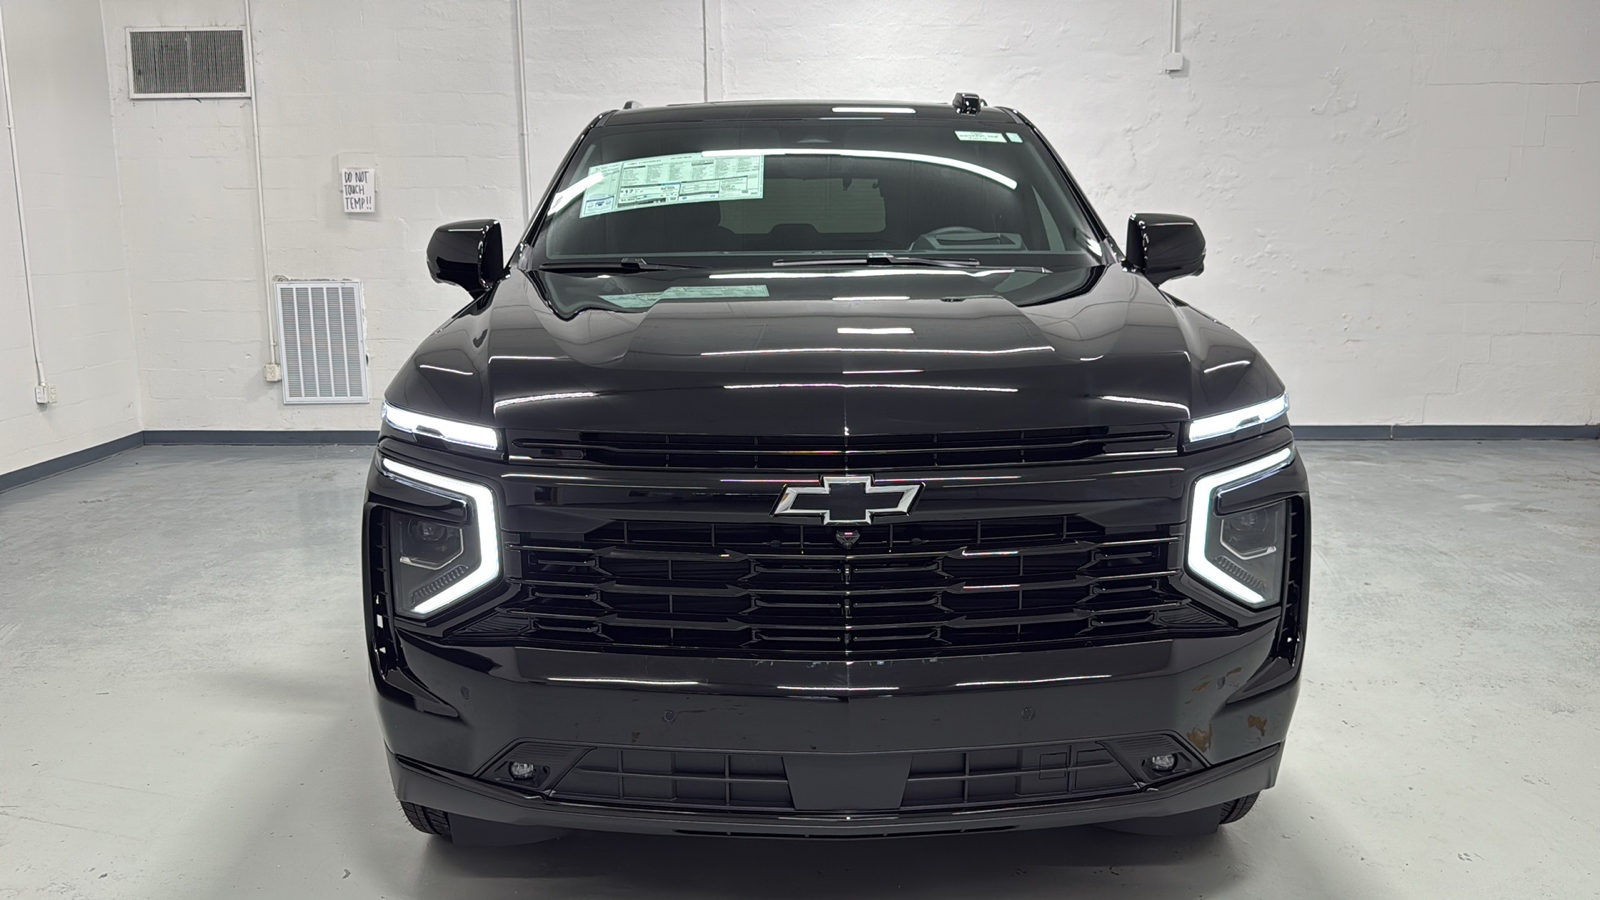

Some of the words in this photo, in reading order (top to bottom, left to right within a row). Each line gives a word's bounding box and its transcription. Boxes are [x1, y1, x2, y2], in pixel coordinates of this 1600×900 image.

[344, 171, 352, 183] DO
[355, 171, 369, 183] NOT
[344, 185, 365, 196] TOUCH
[345, 196, 371, 210] TEMP!!
